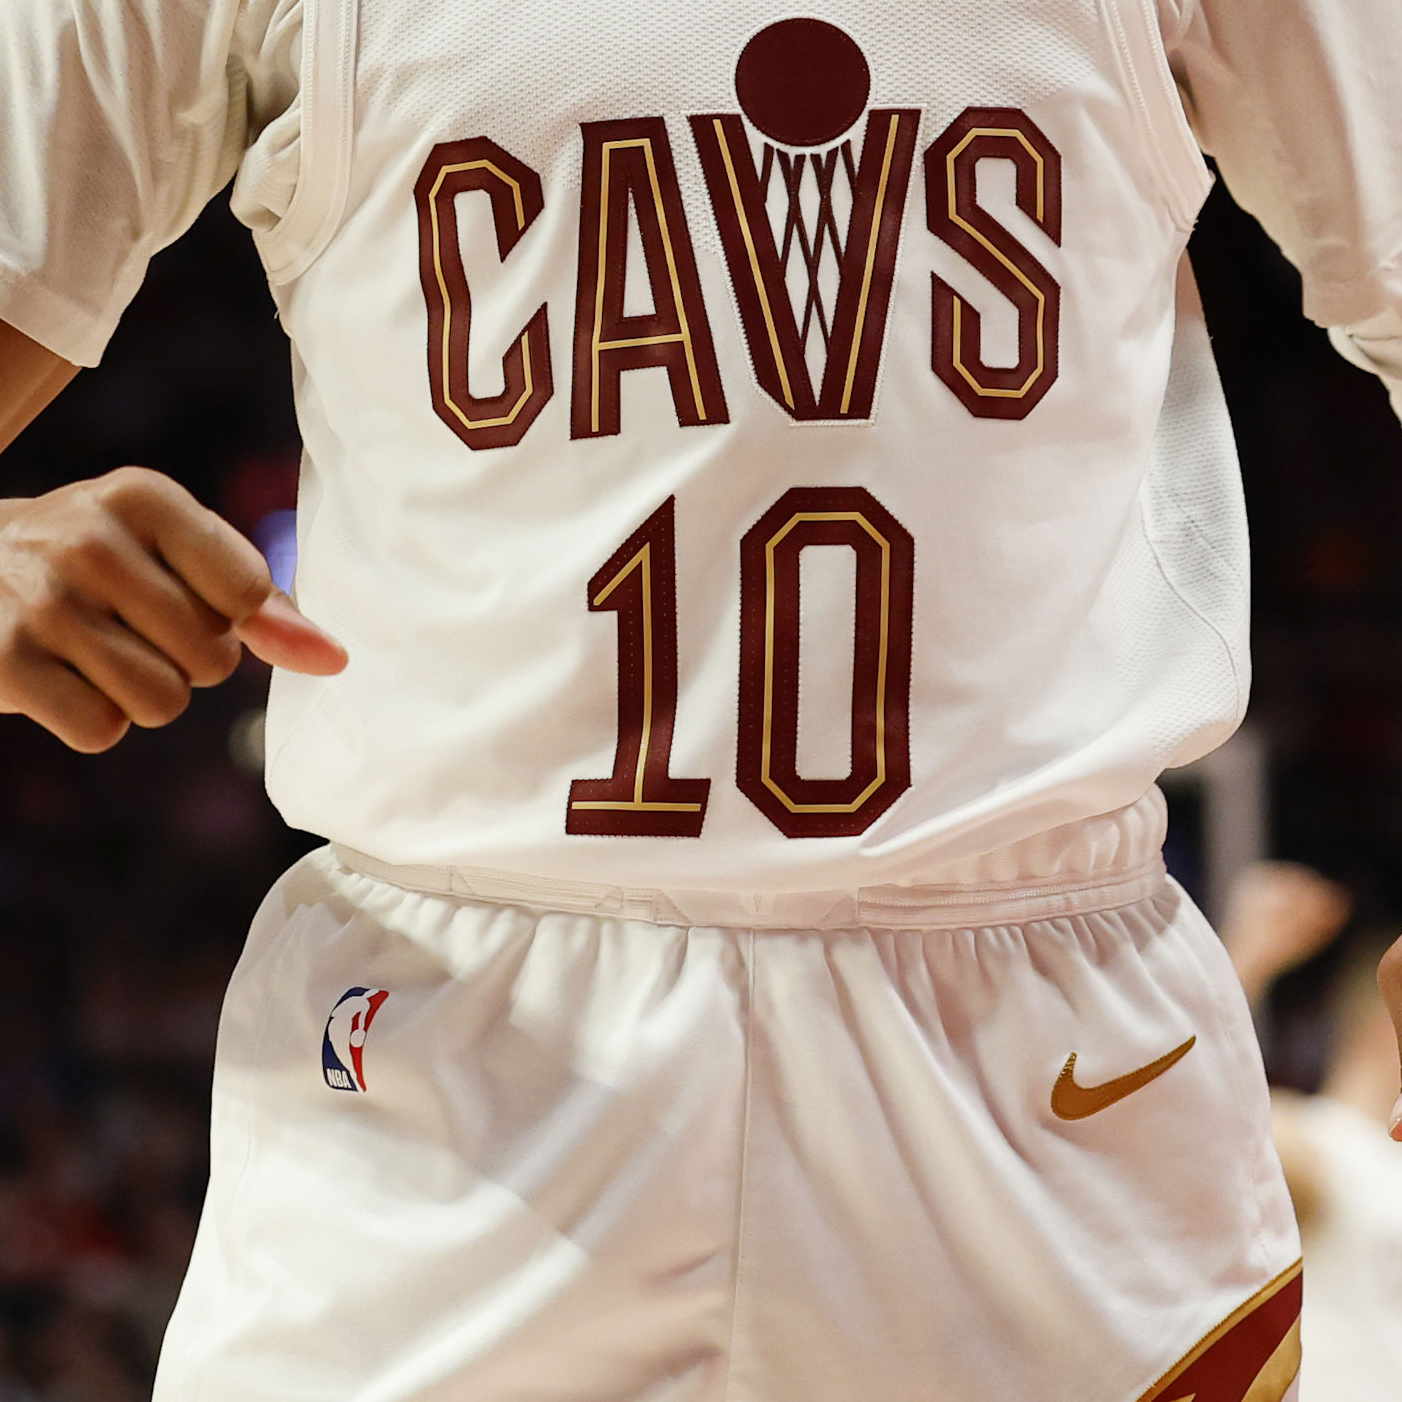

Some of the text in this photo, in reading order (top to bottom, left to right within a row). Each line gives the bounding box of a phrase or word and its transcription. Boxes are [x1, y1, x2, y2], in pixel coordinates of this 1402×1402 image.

[413, 105, 1063, 451] CAVS
[564, 485, 916, 839] 10
[326, 1068, 352, 1089] NBA
